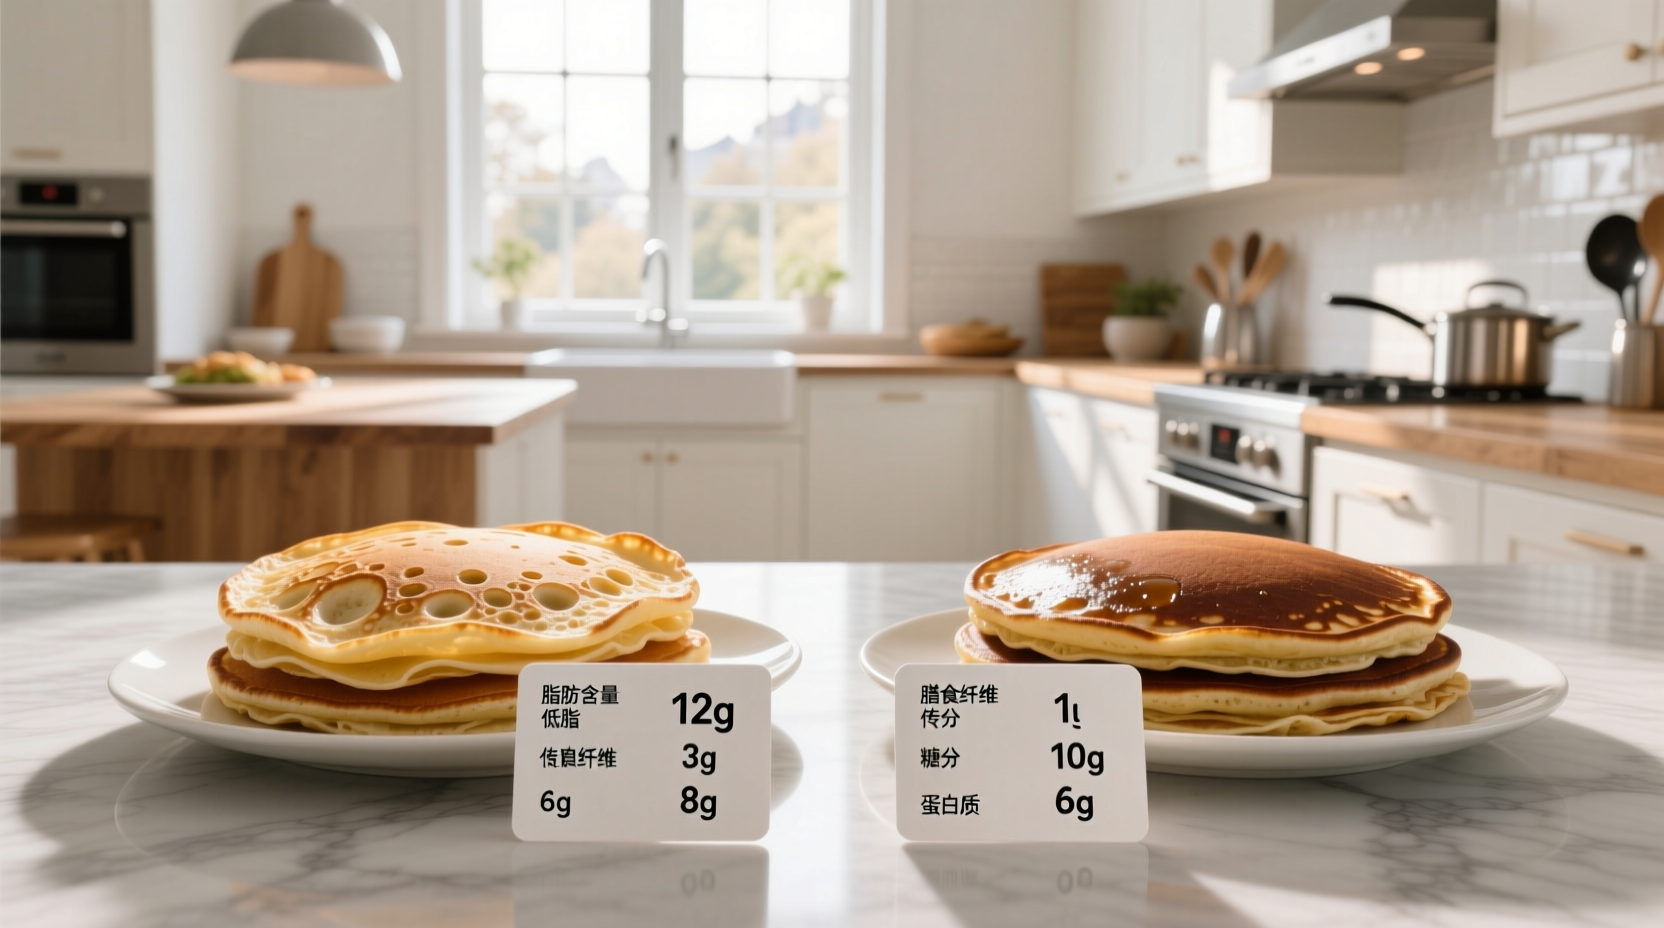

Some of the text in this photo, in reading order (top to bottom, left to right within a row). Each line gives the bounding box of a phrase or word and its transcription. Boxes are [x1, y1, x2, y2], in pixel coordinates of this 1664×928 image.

[541, 684, 619, 704] 脂肪含量
[541, 707, 580, 728] 低脂
[672, 692, 734, 733] 12g
[682, 743, 716, 775] 3g
[921, 747, 960, 768] 糖分
[1051, 742, 1104, 776] 10g
[540, 790, 571, 818] 6g
[681, 786, 716, 821] 8g
[921, 794, 980, 816] 蛋白质
[1056, 786, 1093, 821] 6g
